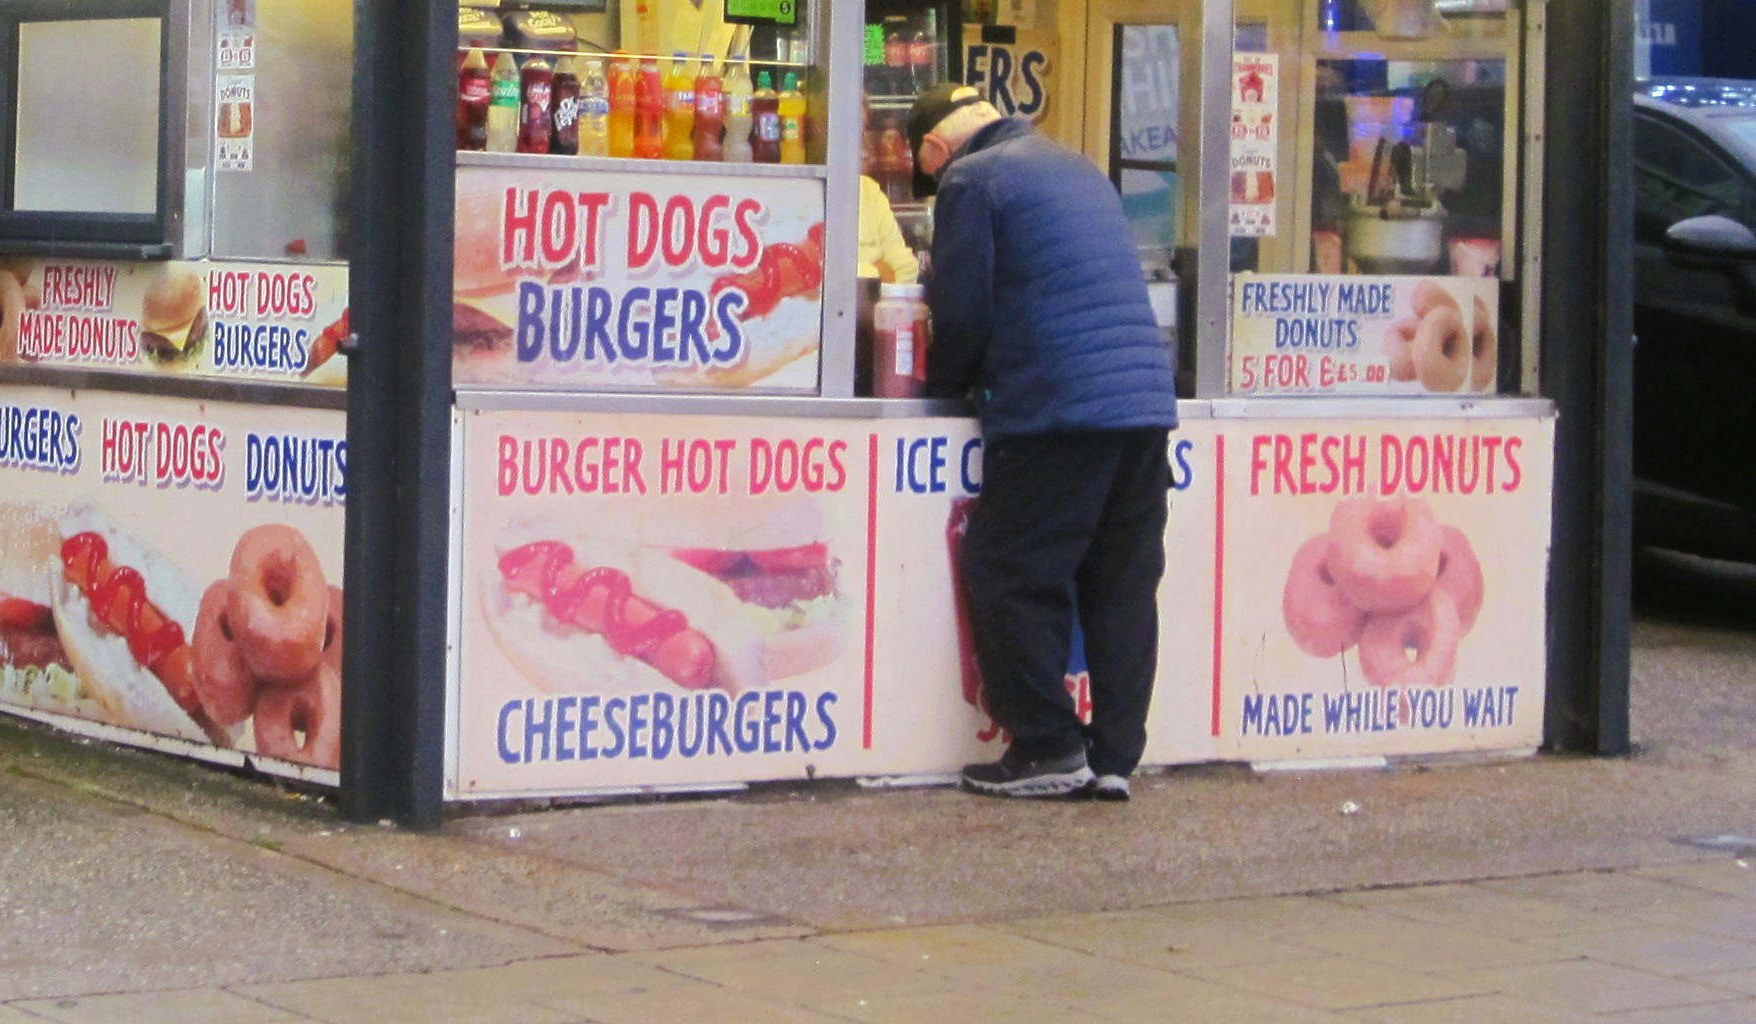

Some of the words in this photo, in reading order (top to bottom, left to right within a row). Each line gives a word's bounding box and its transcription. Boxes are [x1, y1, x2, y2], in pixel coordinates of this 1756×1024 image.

[220, 86, 251, 102] DONUTS
[1231, 155, 1271, 168] DONUTS
[504, 186, 607, 270] HOT
[626, 194, 763, 270] DOGS
[45, 266, 116, 308] FRESHLY
[208, 270, 246, 313] HOT
[257, 272, 315, 316] DOGS
[1242, 282, 1330, 313] FRESHLY
[1337, 284, 1393, 314] MADE
[18, 313, 62, 356] MADE
[65, 315, 139, 360] DONUTS
[214, 322, 308, 371] BURGERS
[516, 281, 747, 364] BURGERS
[1275, 318, 1358, 348] DONUTS
[1240, 354, 1256, 389] 5
[1264, 354, 1311, 389] FOR
[102, 418, 150, 479] HOT
[155, 422, 224, 484] DOGS
[247, 433, 348, 498] DONUTS
[498, 435, 646, 496] BURGER
[660, 437, 736, 496] HOT
[750, 437, 848, 495] DOGS
[895, 436, 948, 493] ICE
[1249, 434, 1367, 496] FRESH
[1380, 435, 1523, 495] DONUTS
[497, 689, 838, 764] CHEESEBURGERS
[1241, 692, 1313, 736] MADE
[1323, 689, 1400, 733] WHILE
[1407, 687, 1455, 729] YOU
[1461, 686, 1520, 729] WAIT
